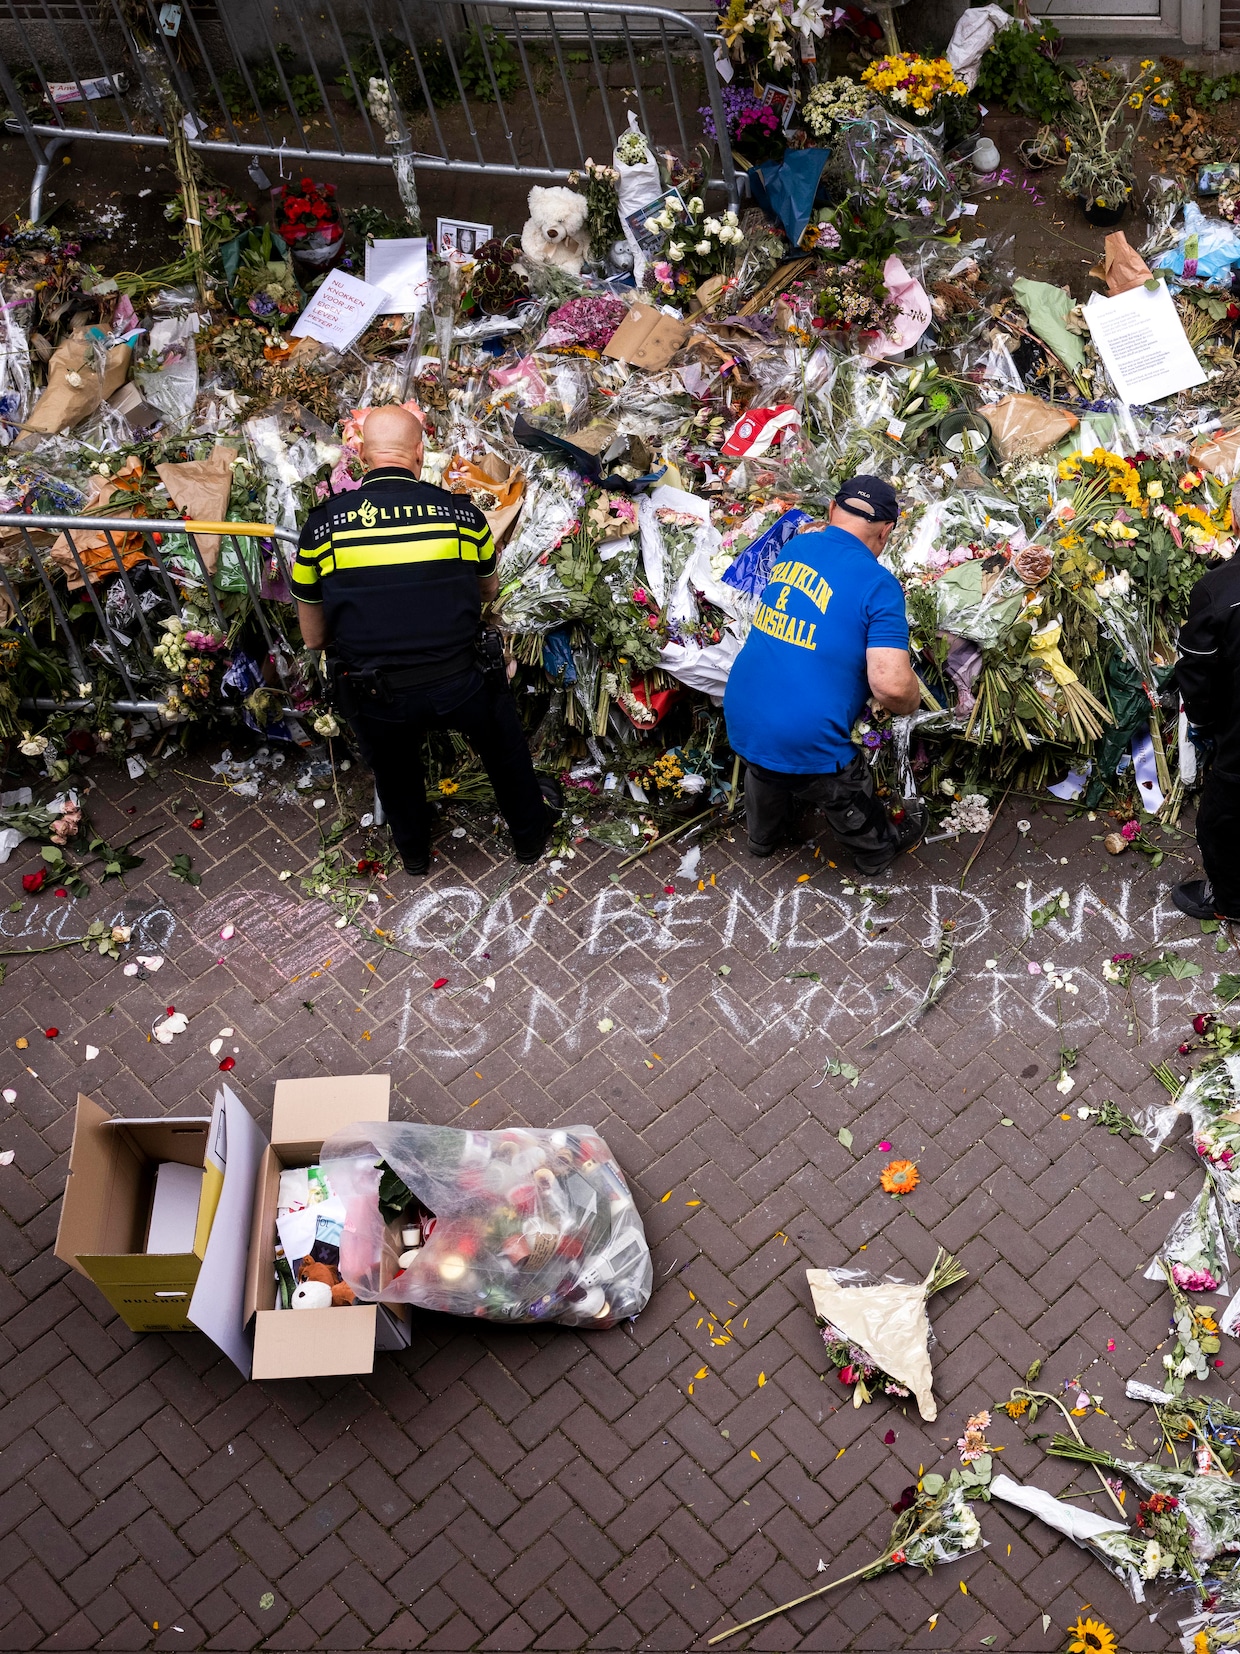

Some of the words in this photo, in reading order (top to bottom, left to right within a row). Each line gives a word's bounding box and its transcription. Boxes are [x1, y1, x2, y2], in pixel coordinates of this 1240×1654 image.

[331, 279, 345, 289] NU
[322, 293, 345, 307] VOOR
[344, 303, 355, 313] JE
[326, 286, 366, 307] KNOKKEN
[312, 307, 339, 323] LEVEN
[316, 300, 342, 316] EIGEN
[307, 313, 333, 328] PETER
[767, 560, 834, 615] FRANKLIN
[775, 585, 789, 612] &
[588, 884, 992, 956] BENDED
[399, 985, 490, 1059] IS
